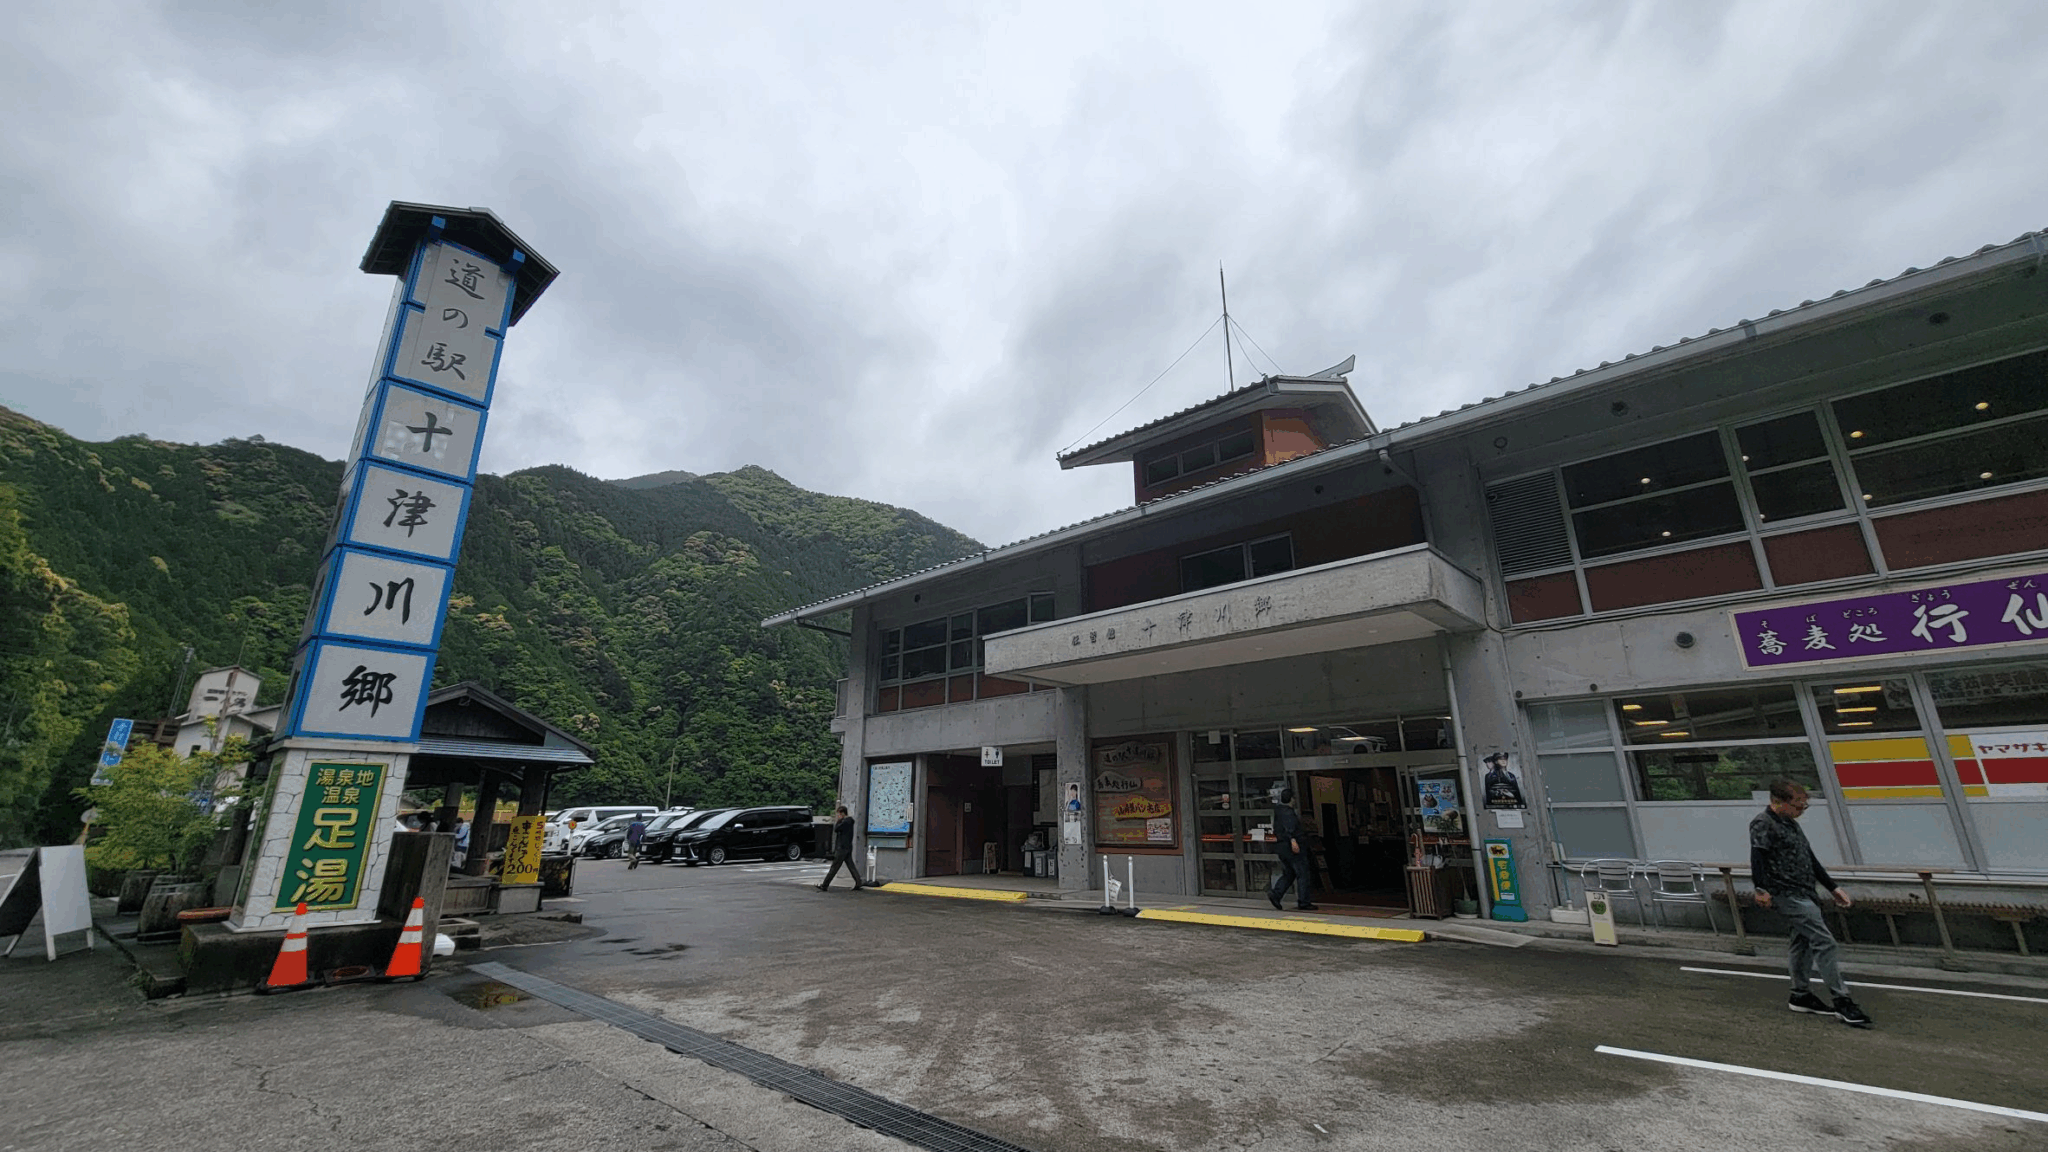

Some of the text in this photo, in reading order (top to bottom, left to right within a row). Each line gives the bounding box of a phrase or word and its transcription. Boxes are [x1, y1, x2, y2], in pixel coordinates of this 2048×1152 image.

[338, 257, 486, 719] 道の駅 十津川郷
[1757, 592, 2048, 656] 蕎麦処 行仙
[1760, 579, 2037, 629] そ ば どころ ぎょう ぜん
[315, 767, 376, 787] 湯泉地
[321, 786, 361, 805] 温泉
[290, 807, 360, 903] 足湯
